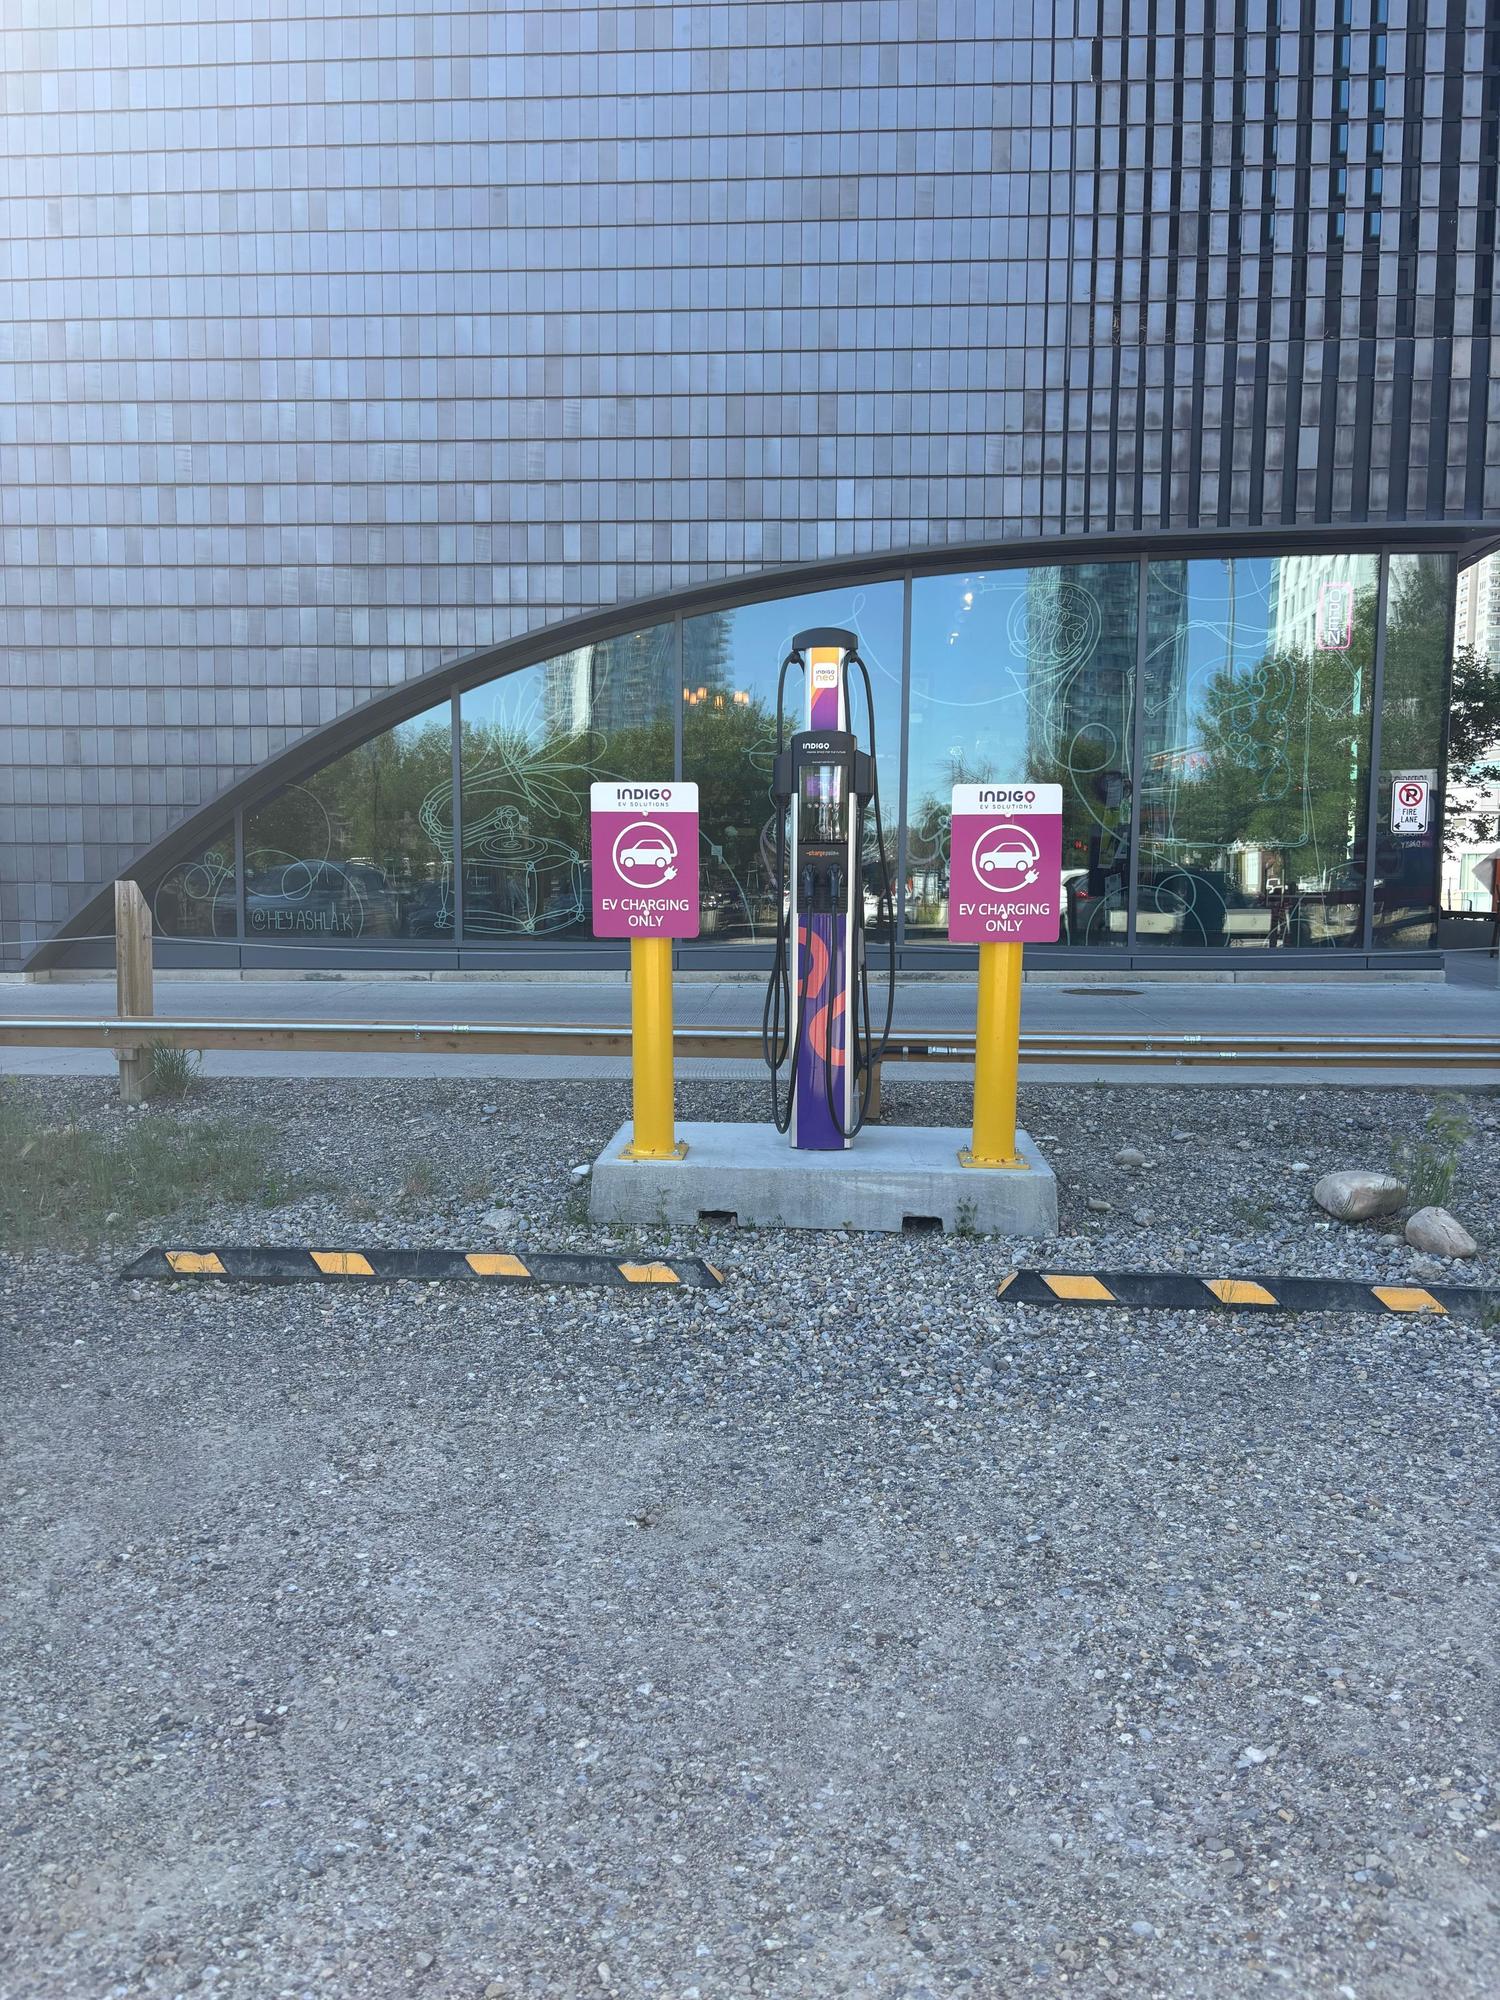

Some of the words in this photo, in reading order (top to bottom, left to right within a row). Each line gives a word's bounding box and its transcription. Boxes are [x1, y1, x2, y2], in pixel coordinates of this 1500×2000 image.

[1328, 588, 1342, 645] OPEN
[802, 742, 830, 750] INDIGO
[617, 788, 672, 801] INDIGO
[979, 790, 1036, 803] INDIGO
[602, 899, 617, 911] EV
[621, 899, 689, 911] CHARGING
[959, 904, 975, 916] EV
[978, 904, 1050, 916] CHARGING
[628, 915, 664, 927] ONLY
[985, 920, 1023, 932] ONLY
